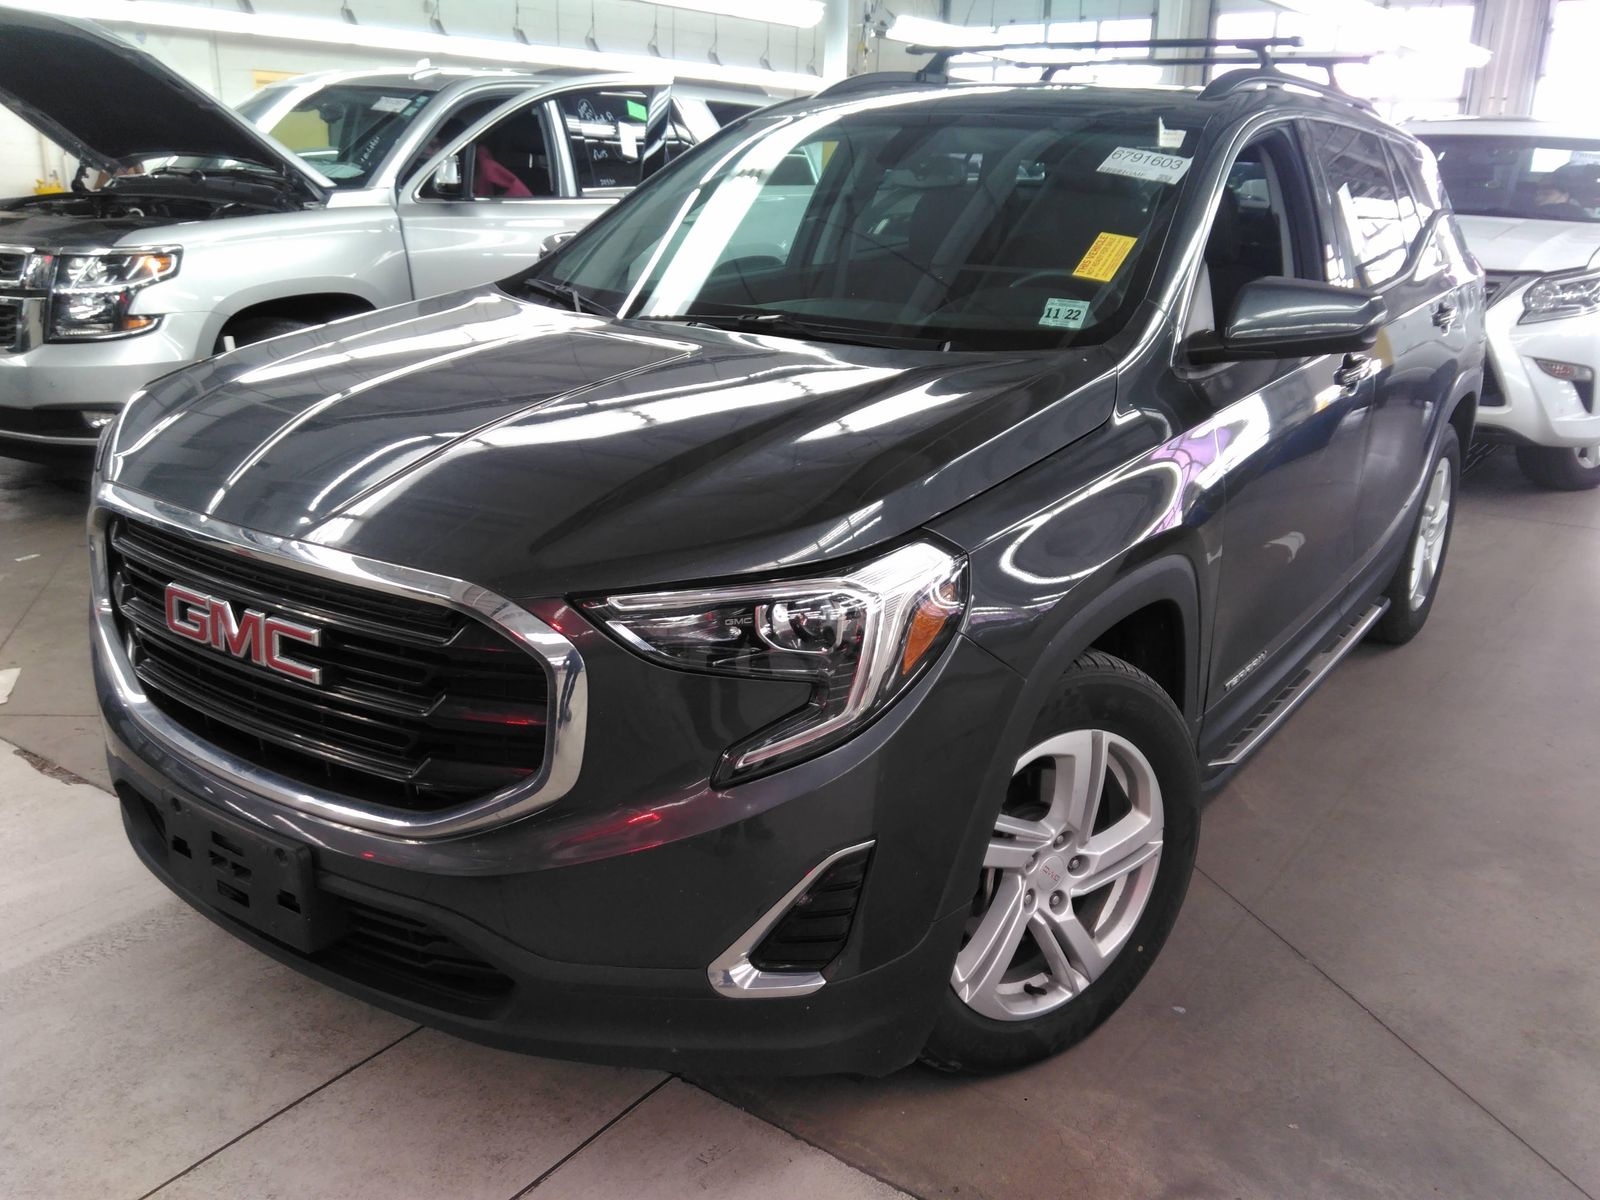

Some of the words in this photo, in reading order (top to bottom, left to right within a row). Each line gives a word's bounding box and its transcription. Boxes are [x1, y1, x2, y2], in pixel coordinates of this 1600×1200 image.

[1111, 149, 1184, 170] 6791603
[1076, 259, 1091, 273] THIS
[1088, 235, 1109, 260] VEHICLE
[1044, 307, 1061, 319] 11
[1064, 308, 1082, 321] 22
[164, 582, 322, 685] GMC
[725, 617, 753, 626] GMC
[1224, 650, 1268, 692] TERRAIN
